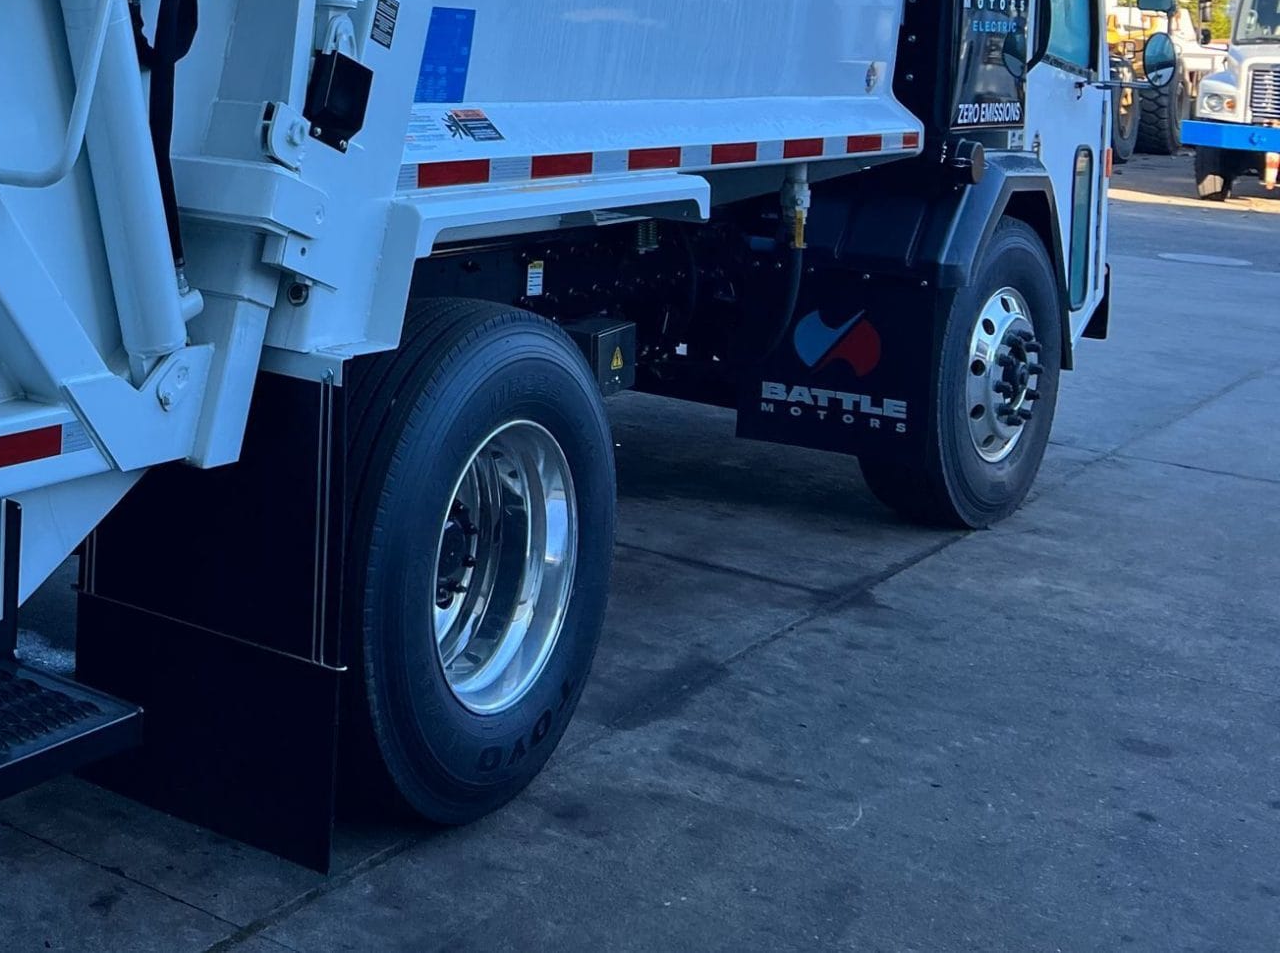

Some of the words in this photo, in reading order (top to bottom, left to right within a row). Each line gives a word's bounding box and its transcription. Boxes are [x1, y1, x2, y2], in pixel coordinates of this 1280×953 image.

[973, 20, 1017, 33] ELECTRIC
[958, 102, 980, 124] ZERO
[980, 102, 1021, 123] EMISSIONS
[761, 381, 907, 419] BATTLE
[761, 402, 907, 433] MOTORS
